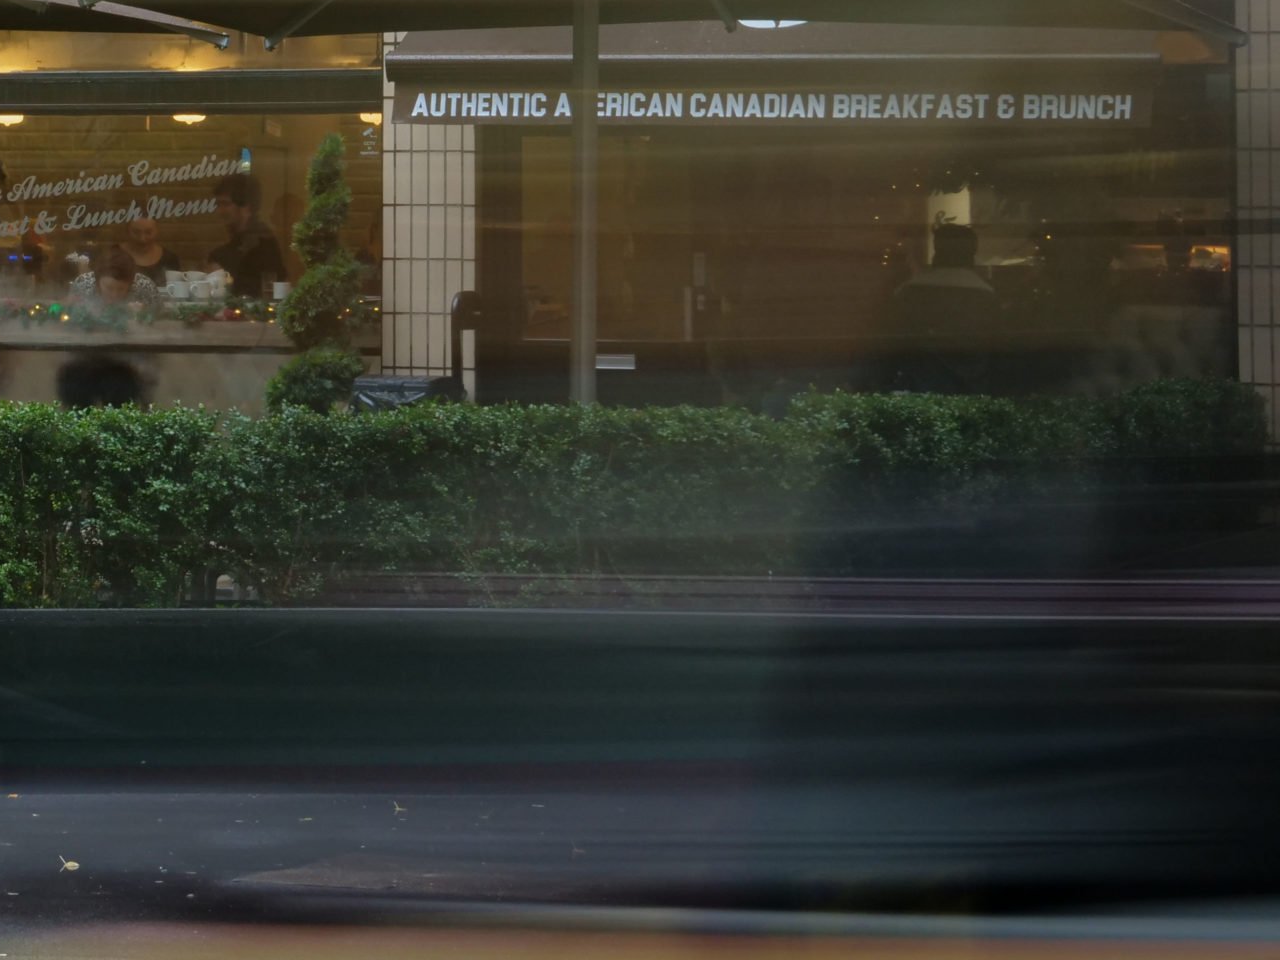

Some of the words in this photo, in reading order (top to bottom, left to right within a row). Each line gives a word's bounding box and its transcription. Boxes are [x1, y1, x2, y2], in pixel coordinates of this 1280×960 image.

[411, 92, 547, 117] AUTHENTIC
[553, 92, 683, 118] AERICAN
[689, 92, 825, 119] CANADIAN
[832, 93, 990, 119] BREAKFAST
[997, 94, 1015, 119] &
[1023, 94, 1132, 120] BRUNCH
[6, 170, 125, 203] American
[127, 154, 246, 187] Canadian
[33, 209, 58, 235] &
[62, 199, 144, 231] Lunch
[146, 195, 218, 220] Menu
